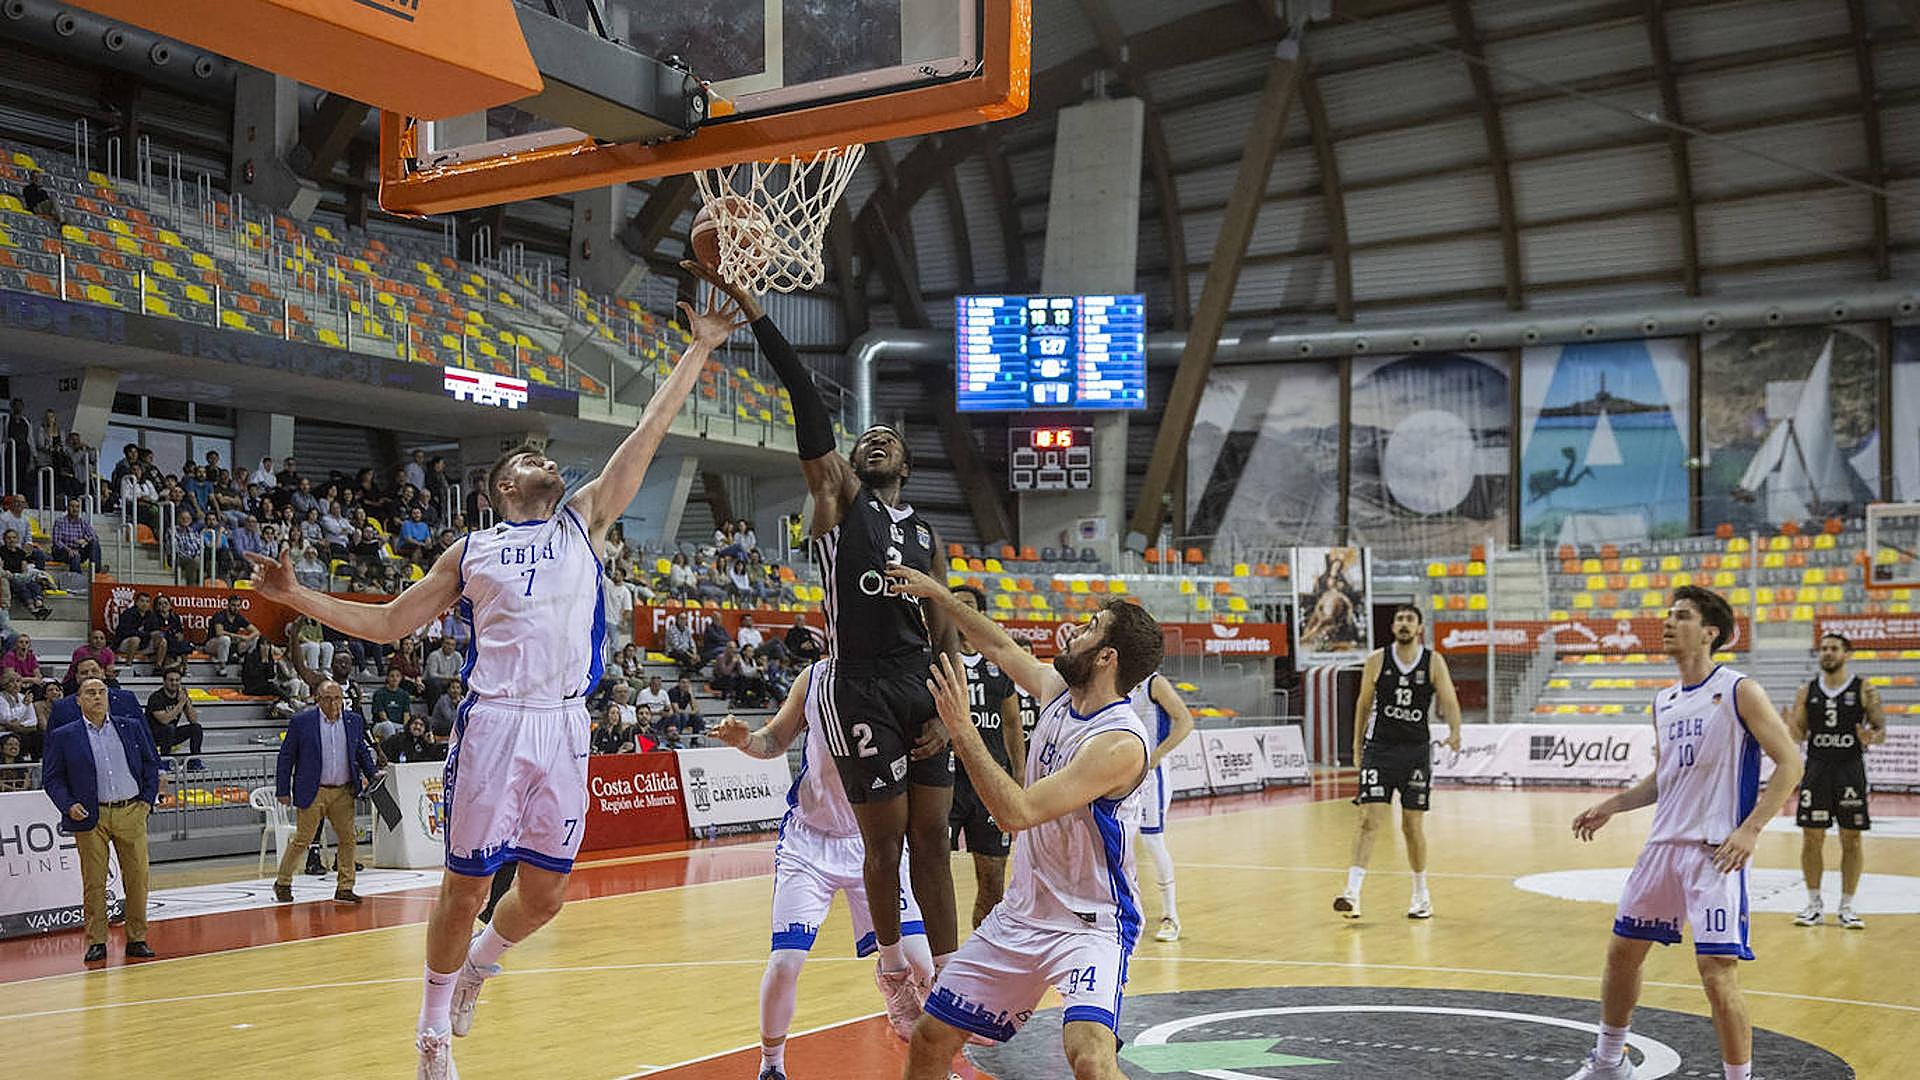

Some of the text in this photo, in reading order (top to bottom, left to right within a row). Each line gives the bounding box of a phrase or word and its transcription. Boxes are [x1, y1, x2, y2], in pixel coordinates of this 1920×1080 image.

[520, 568, 536, 597] 7
[158, 591, 250, 610] yuntamieo
[967, 683, 986, 706] 11
[1394, 688, 1413, 706] 13
[970, 711, 1001, 729] DILO
[1668, 718, 1703, 740] CBLH
[1825, 709, 1837, 727] 3
[852, 722, 878, 758] 2
[1548, 735, 1630, 767] Ayala
[1813, 734, 1855, 748] ODILO
[1679, 744, 1695, 767] 10
[591, 771, 679, 797] Costa Cálida
[1361, 769, 1379, 785] 13
[600, 793, 677, 815] Región de Murcia
[712, 785, 772, 802] CARTAGENA
[1800, 790, 1812, 808] 3
[562, 819, 578, 846] 7
[9, 855, 71, 877] LINE
[26, 908, 85, 929] VAMOS!
[1705, 907, 1726, 932] 10
[1068, 965, 1097, 994] 94
